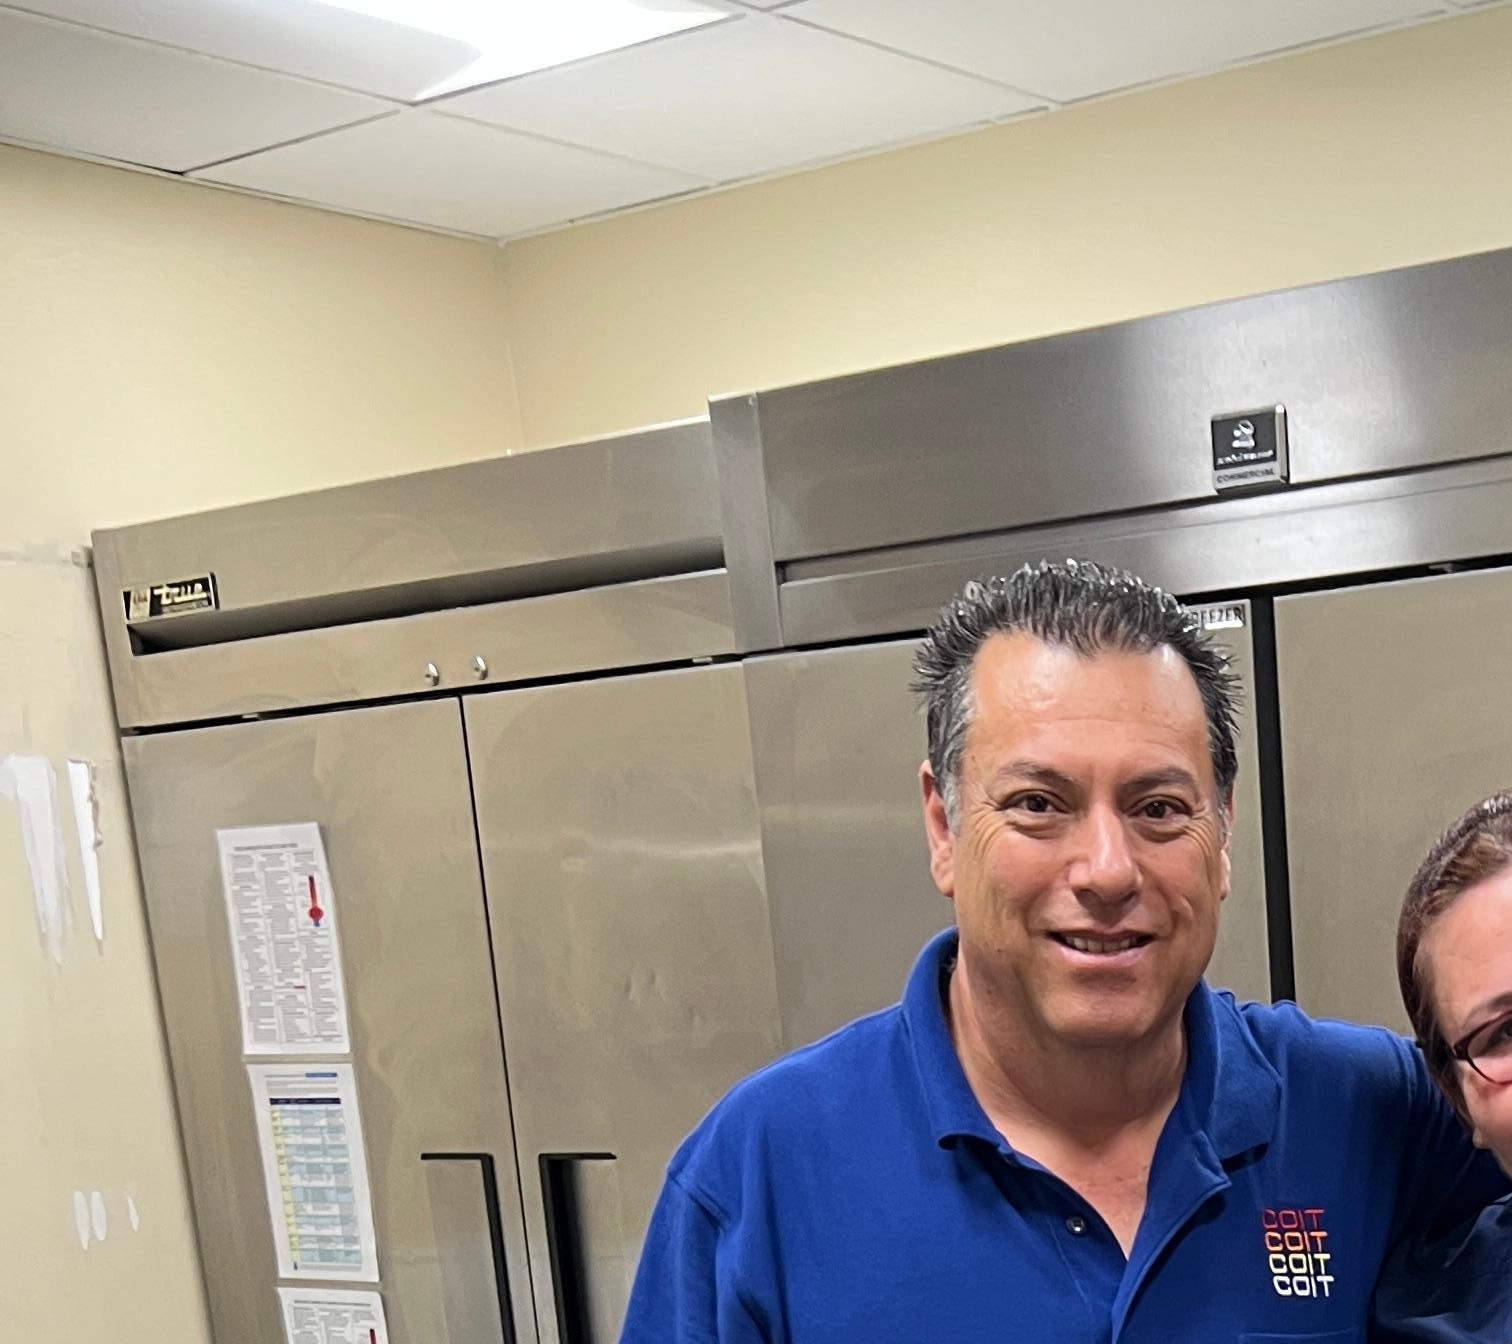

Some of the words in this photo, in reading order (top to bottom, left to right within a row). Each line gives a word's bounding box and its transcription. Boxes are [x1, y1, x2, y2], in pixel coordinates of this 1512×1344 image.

[1263, 1209, 1325, 1230] COIT
[1265, 1231, 1328, 1252] COIT
[1269, 1253, 1331, 1274] COIT
[1273, 1275, 1335, 1298] COIT
